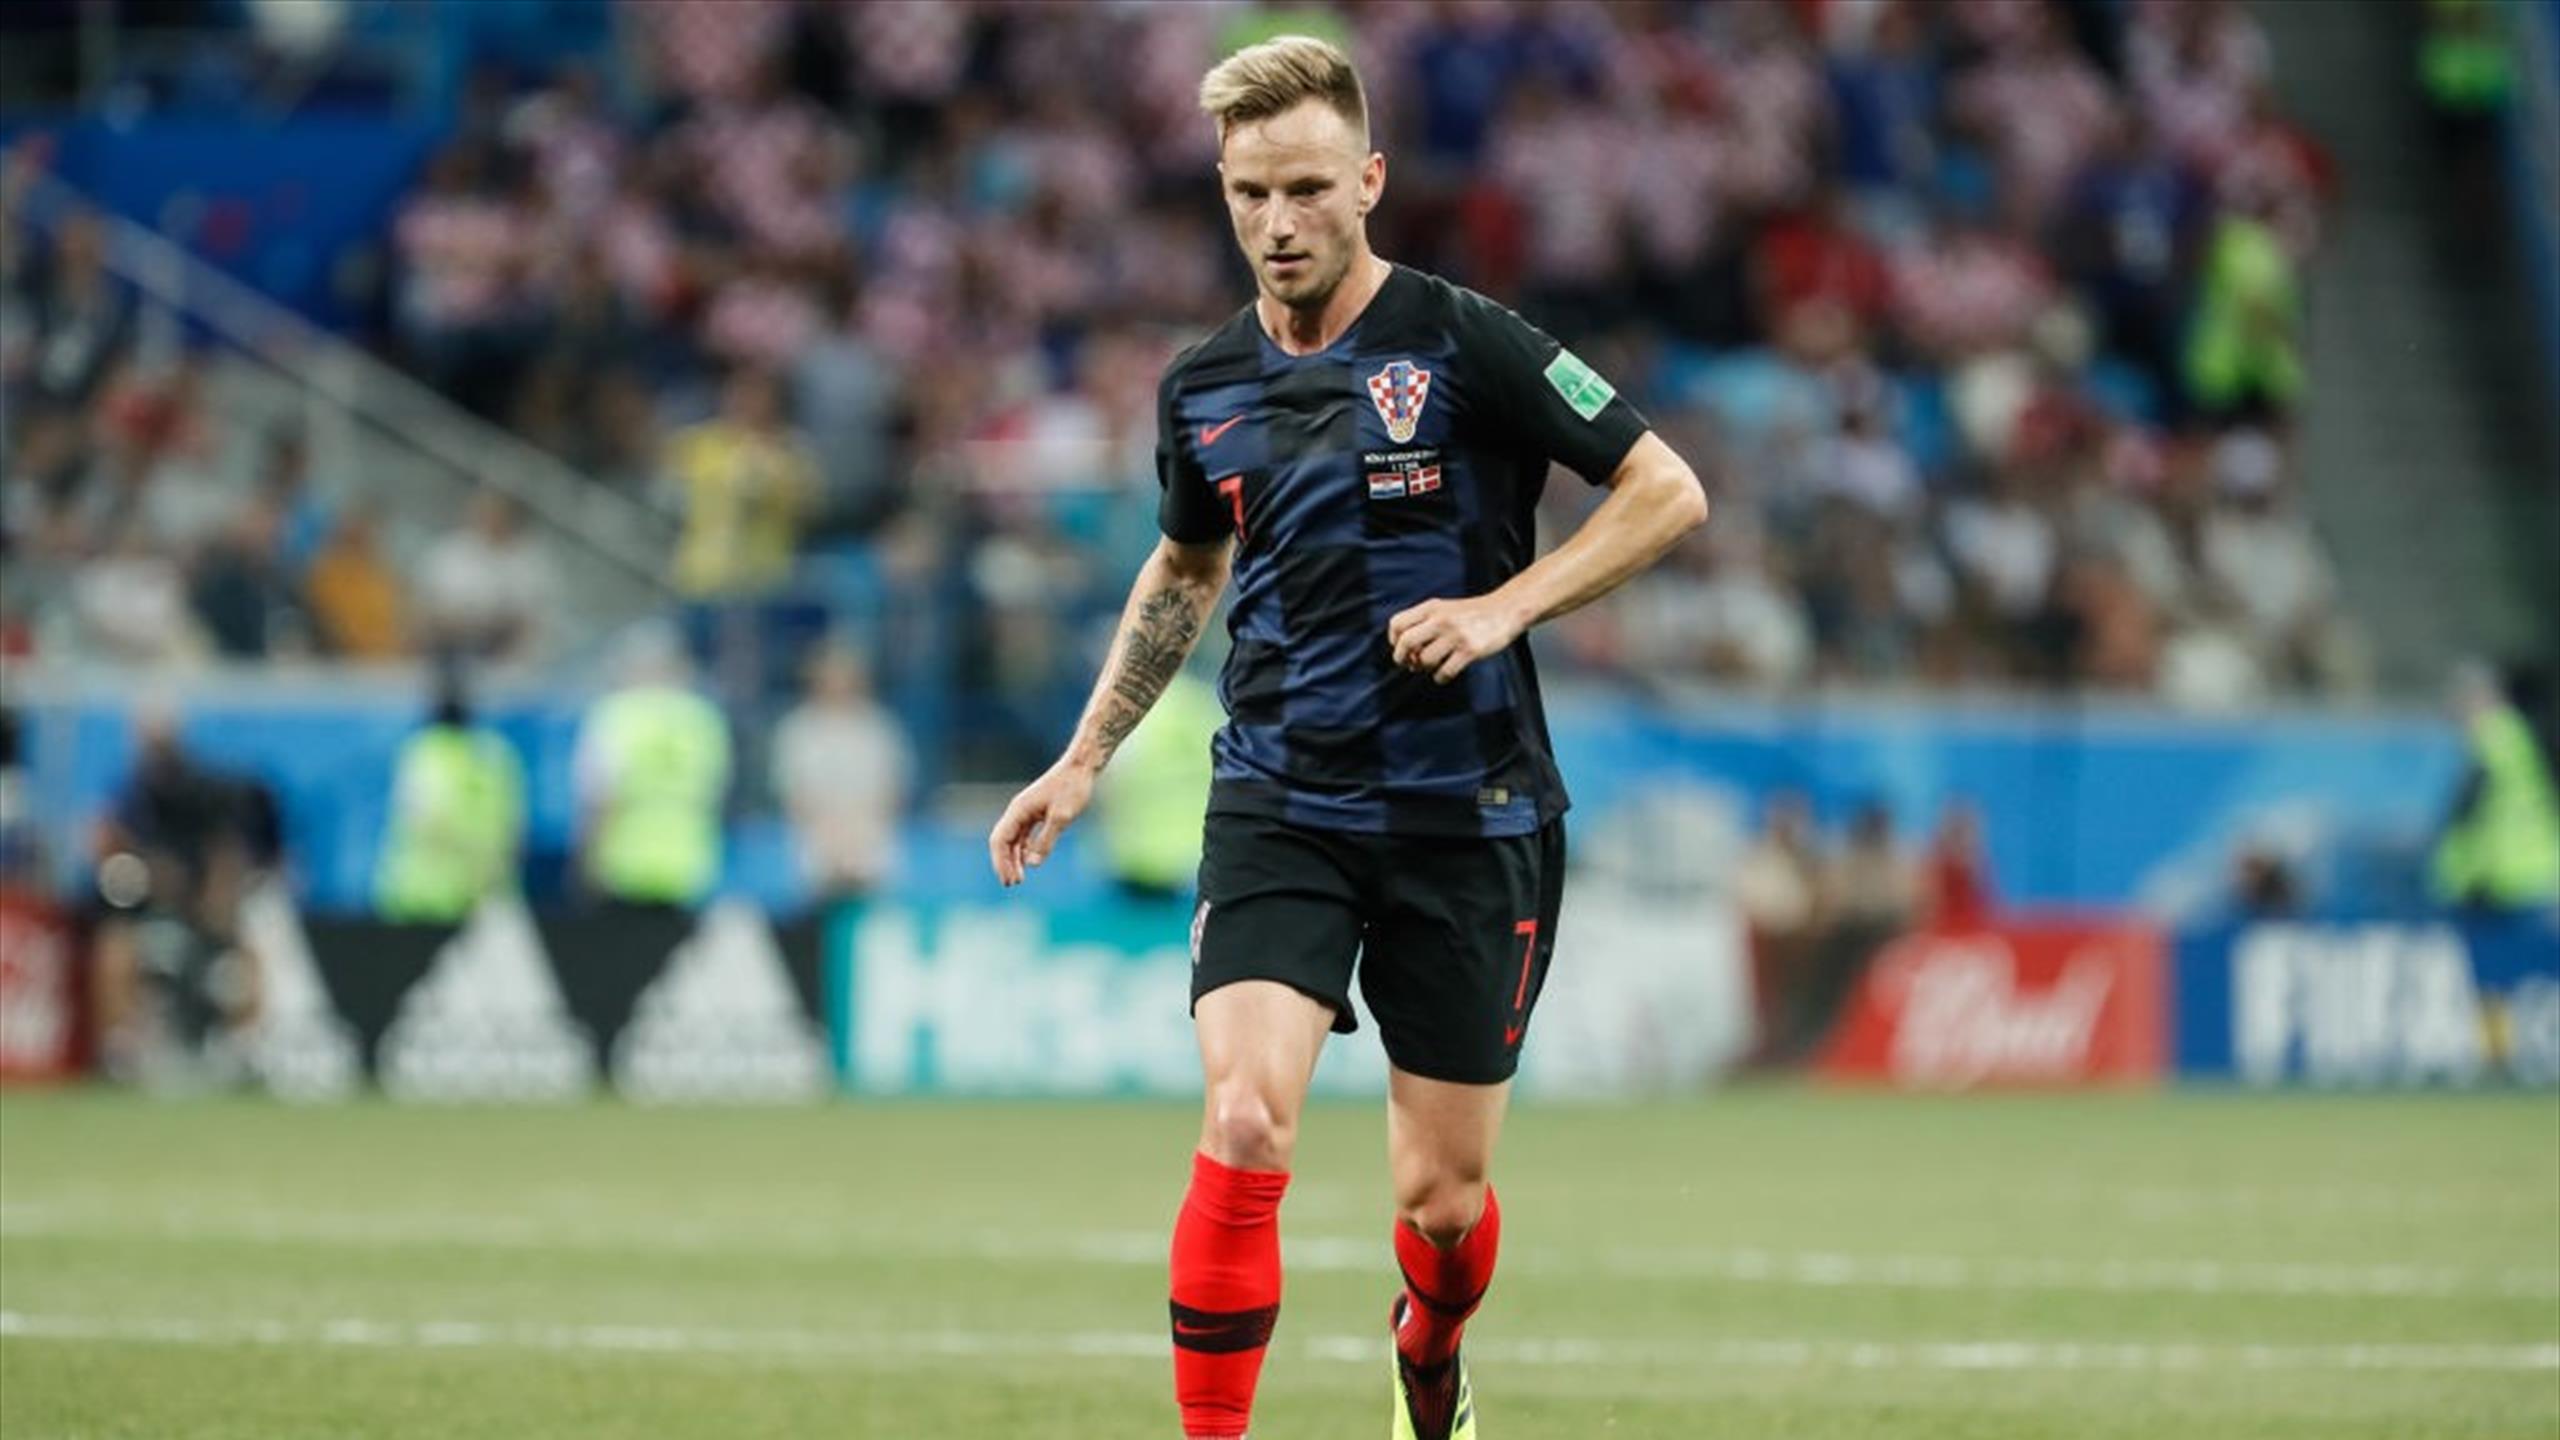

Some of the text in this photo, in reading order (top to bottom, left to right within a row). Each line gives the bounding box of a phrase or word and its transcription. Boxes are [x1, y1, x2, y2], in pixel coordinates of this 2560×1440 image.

[1217, 475, 1247, 543] 7
[850, 902, 1196, 1090] Hise
[1514, 919, 1538, 1010] 7
